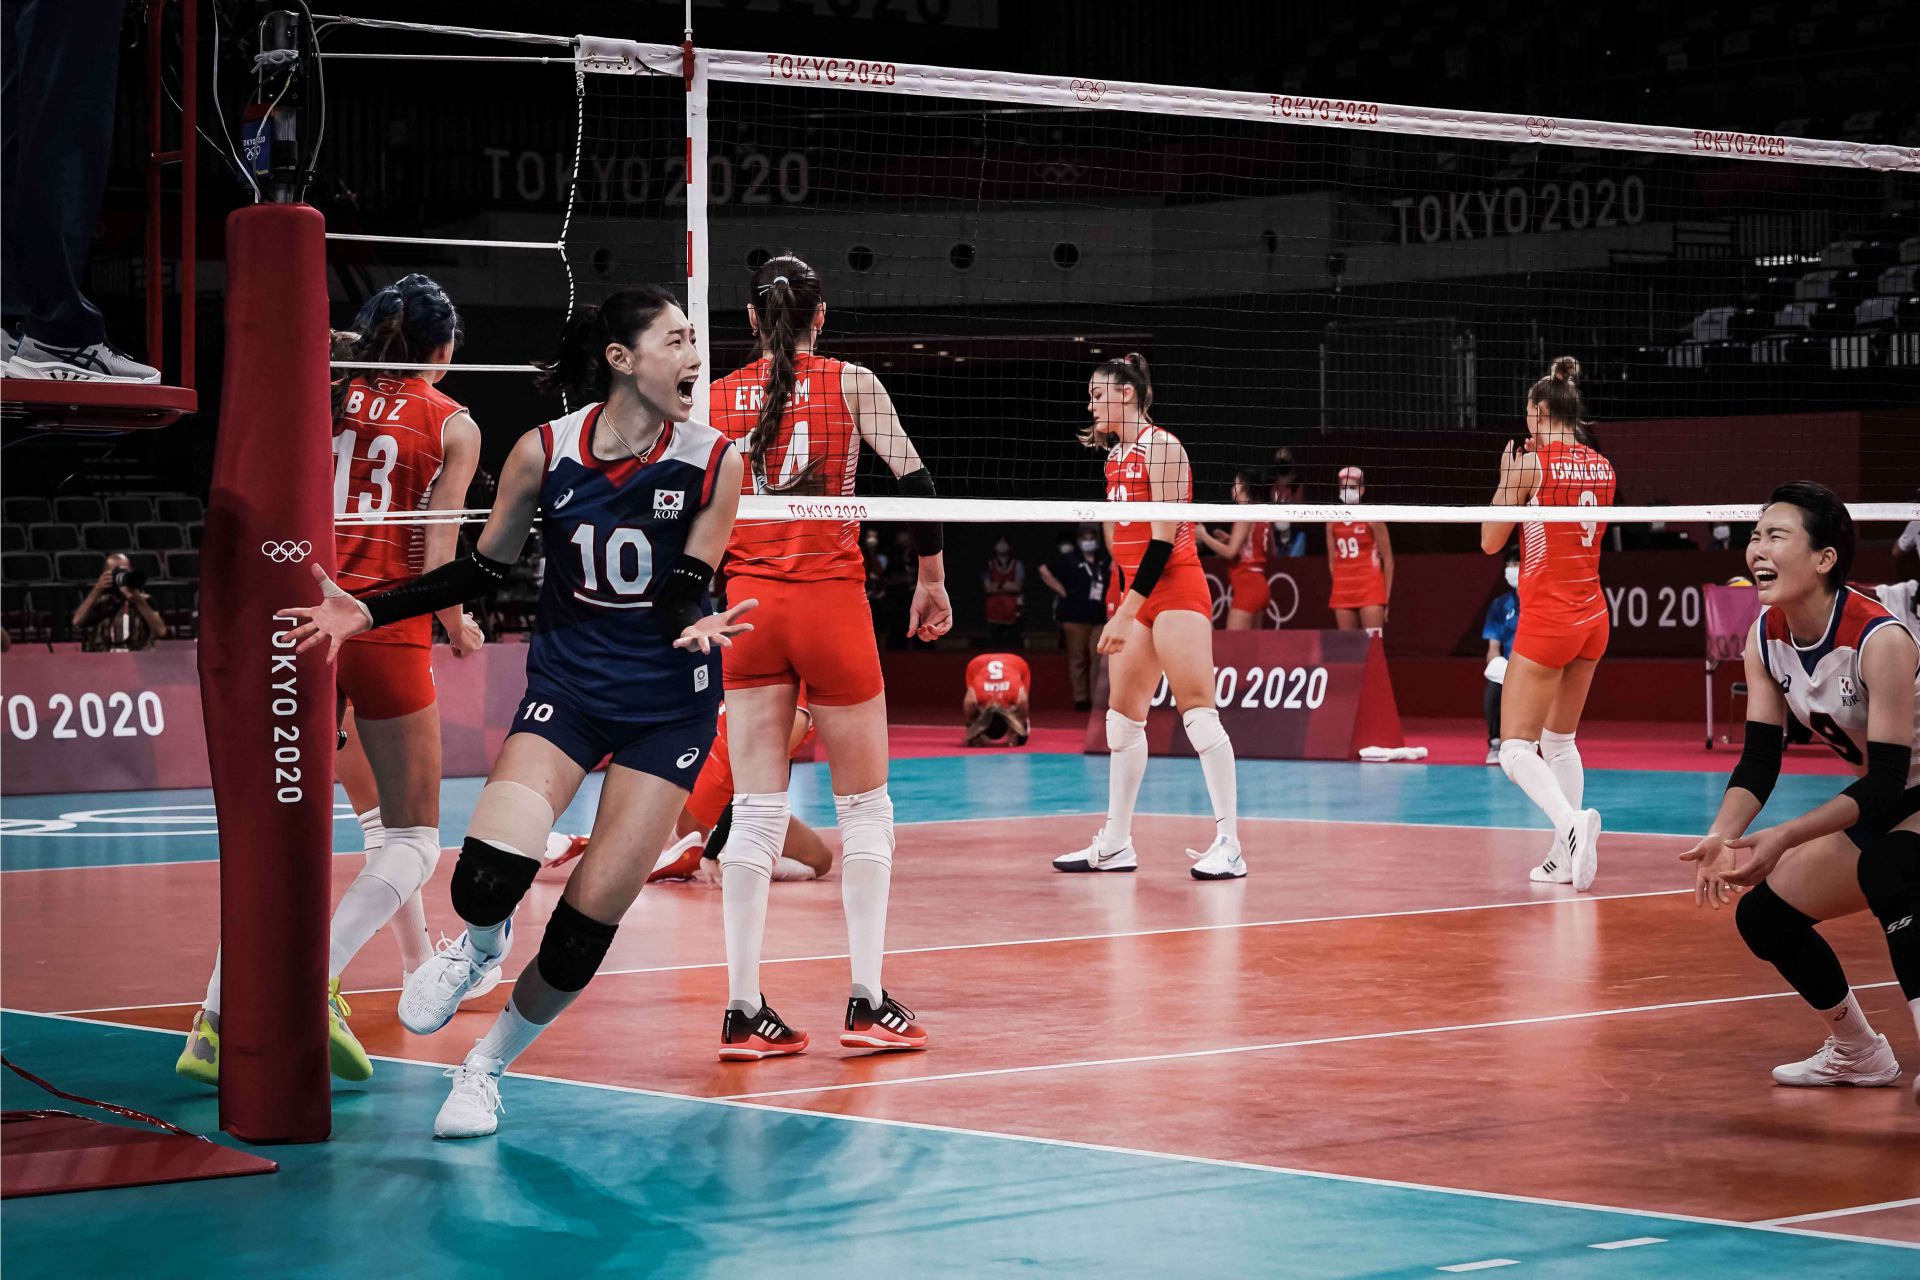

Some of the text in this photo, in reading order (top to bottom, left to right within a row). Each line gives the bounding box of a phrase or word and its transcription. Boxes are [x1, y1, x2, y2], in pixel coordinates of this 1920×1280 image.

[767, 55, 896, 86] TOKYO 2020
[1270, 96, 1379, 124] TOKYO 2020
[1693, 131, 1785, 156] TOKYO 2020
[484, 147, 809, 205] TOKYO 2020
[1392, 175, 1645, 245] TOKYO 2020
[345, 390, 407, 421] BOZ
[735, 377, 810, 411] ERM
[332, 428, 399, 521] 13
[653, 510, 679, 520] KOR
[788, 504, 868, 518] TOKYO 2020
[570, 523, 653, 595] 10
[1337, 537, 1360, 558] 99
[1241, 666, 1328, 709] 2020
[48, 690, 165, 739] 2020
[271, 614, 303, 804] TOKYO 2020
[523, 701, 554, 722] 10
